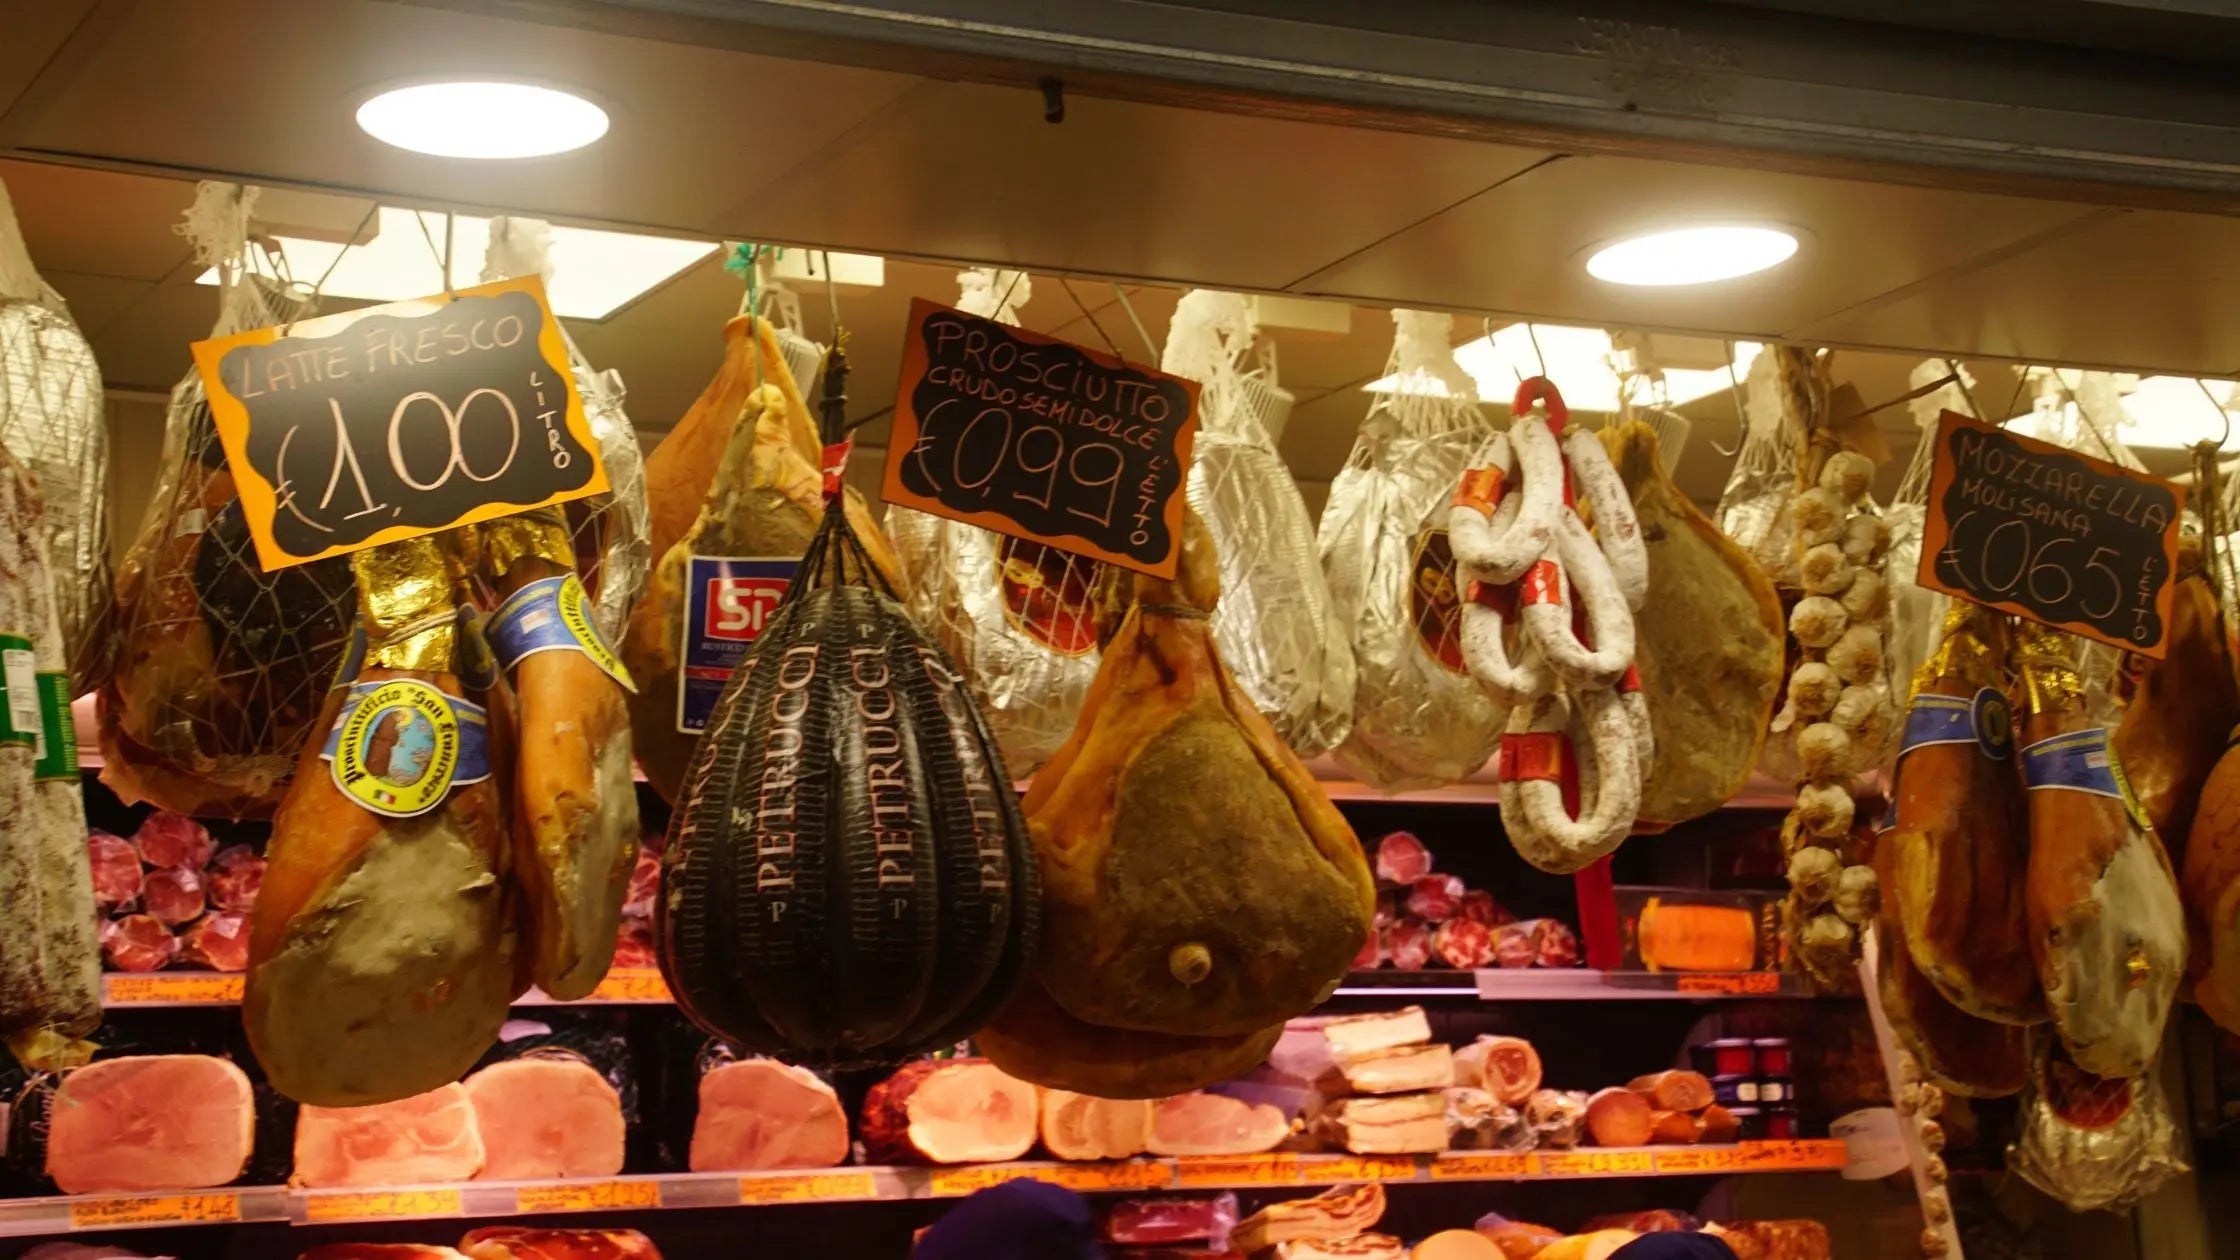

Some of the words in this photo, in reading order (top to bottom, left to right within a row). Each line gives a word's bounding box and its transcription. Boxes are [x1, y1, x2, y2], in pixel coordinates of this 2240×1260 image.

[241, 344, 350, 399] LATTE
[366, 314, 524, 373] FRESCO
[929, 320, 1170, 423] PROSCIUTTO
[529, 371, 572, 470] LITRO
[1957, 434, 2168, 534] MOZZARELLA
[1960, 477, 2092, 537] MOLISANA
[757, 642, 820, 891] PETRUCCI
[850, 643, 915, 889] PETRUCCI
